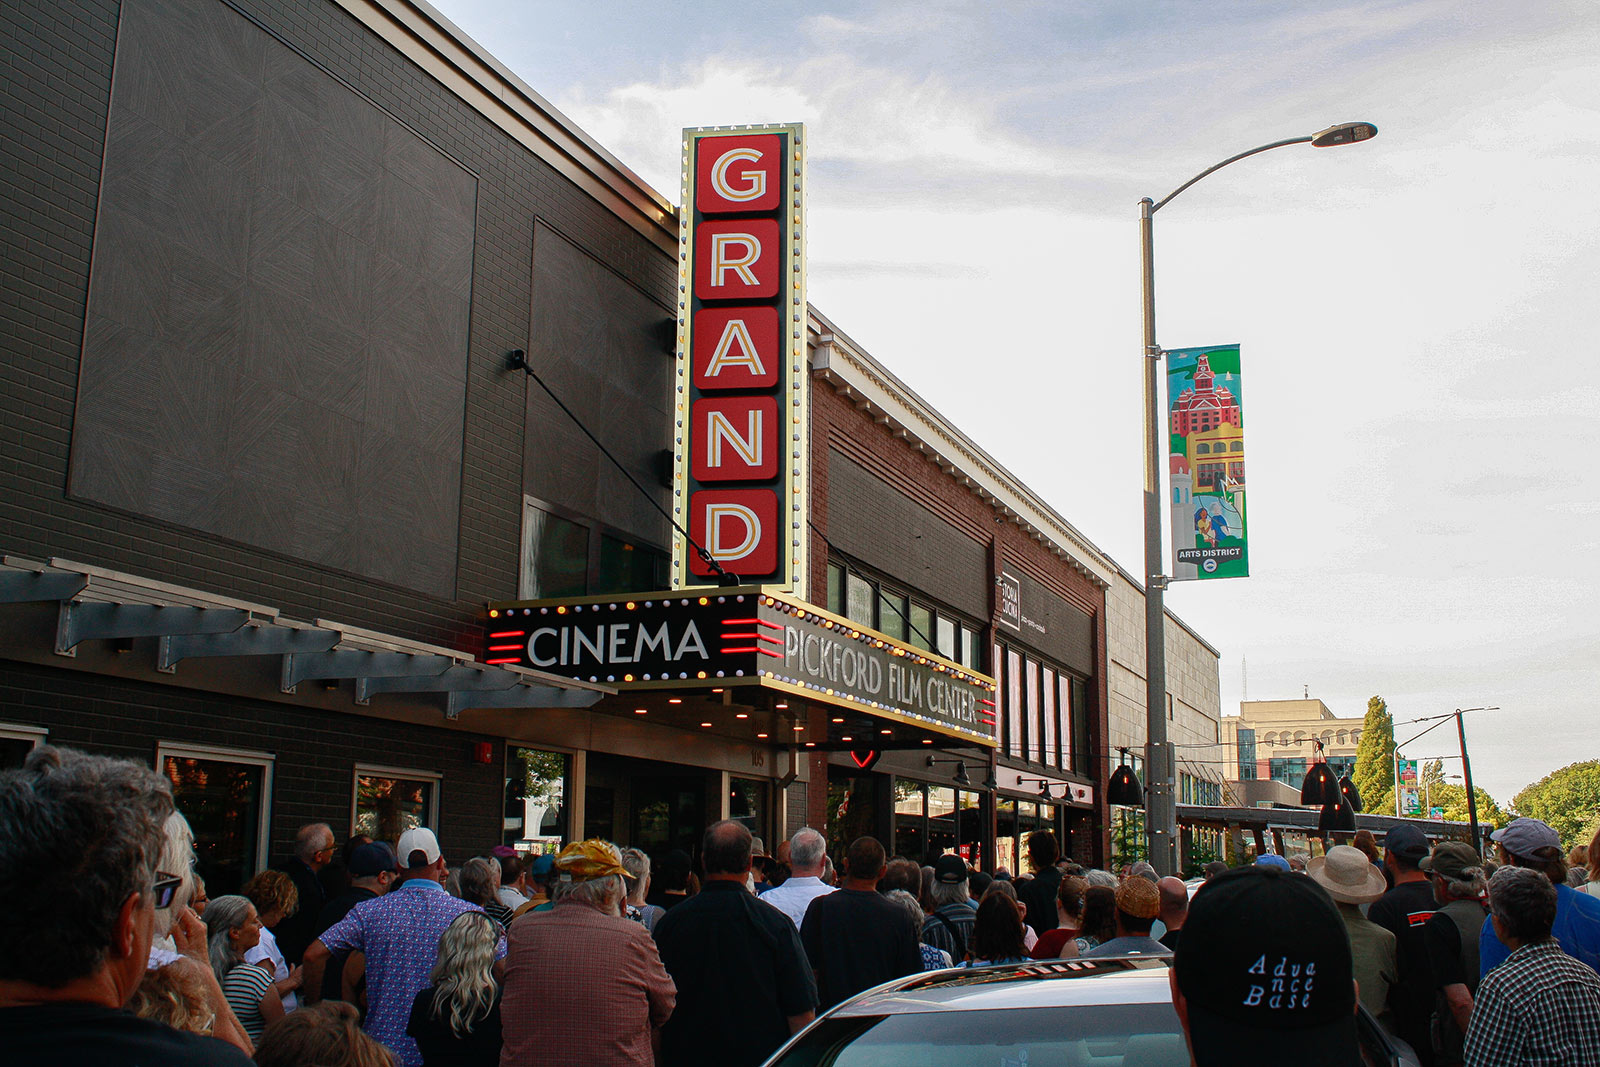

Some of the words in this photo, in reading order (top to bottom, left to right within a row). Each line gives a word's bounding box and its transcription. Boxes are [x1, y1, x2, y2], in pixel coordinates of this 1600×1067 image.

[704, 147, 767, 561] GRAND
[1179, 550, 1201, 559] ARTS
[1202, 547, 1241, 557] DISTRICT
[527, 618, 710, 667] CINEMA
[783, 624, 882, 695] PICKFORD
[887, 662, 923, 708] FILM
[926, 676, 978, 725] CENTER
[1248, 954, 1316, 977] Adva
[1242, 984, 1311, 1009] Base
[1271, 975, 1315, 993] nce
